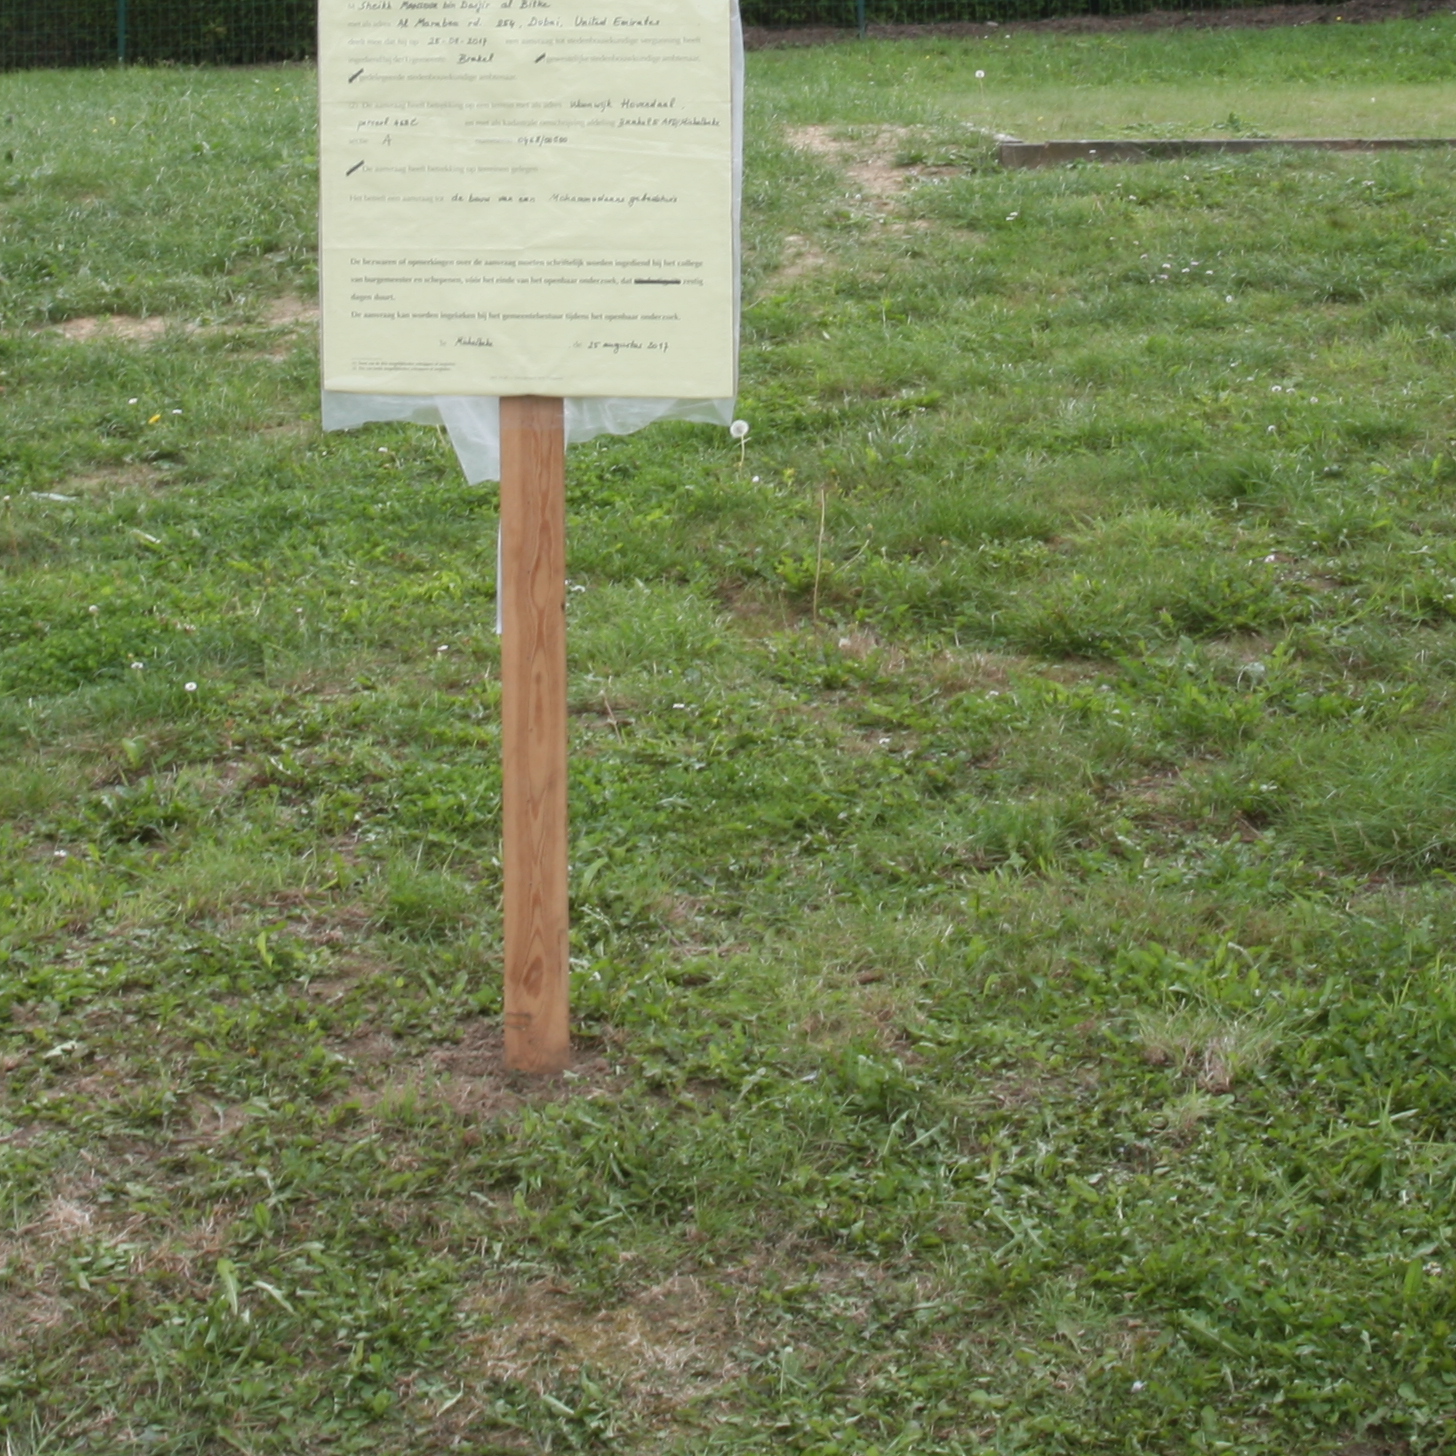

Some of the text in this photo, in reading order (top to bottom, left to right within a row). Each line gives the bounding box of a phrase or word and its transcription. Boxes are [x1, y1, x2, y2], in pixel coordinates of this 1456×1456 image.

[575, 16, 607, 27] United
[613, 15, 661, 27] Emirates
[381, 134, 392, 146] A
[451, 193, 463, 202] de
[362, 257, 397, 265] bezwaren
[484, 259, 516, 267] aanvraag
[364, 276, 412, 285] burgemeester
[544, 276, 578, 286] openbaar
[363, 312, 396, 320] aanvraag
[477, 312, 487, 321] bij
[502, 311, 563, 321] gemeentebestuur
[565, 312, 589, 321] tijdens
[604, 312, 639, 322] openbaar
[588, 341, 601, 349] 25
[602, 340, 642, 354] augustus
